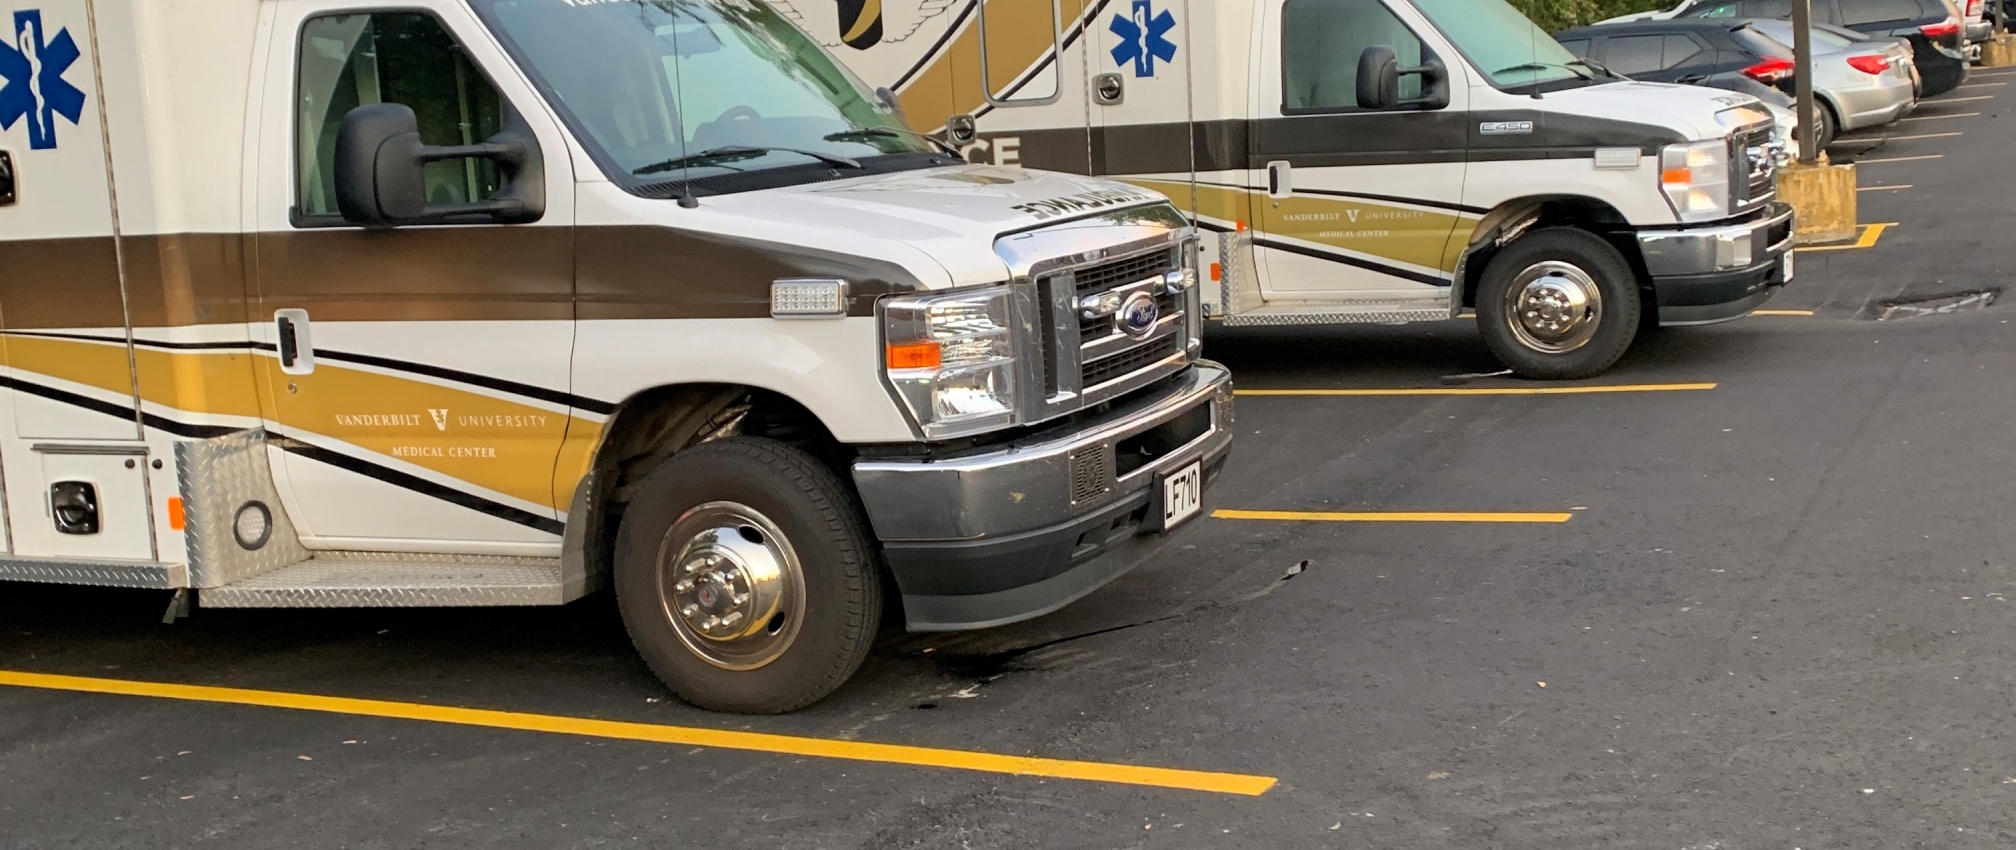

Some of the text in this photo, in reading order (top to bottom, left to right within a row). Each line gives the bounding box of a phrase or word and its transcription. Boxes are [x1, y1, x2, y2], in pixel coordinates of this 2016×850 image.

[1283, 212, 1341, 222] VANDERBILT
[1365, 211, 1425, 220] UNIVERSITY
[1318, 230, 1354, 238] MEDICAL
[335, 414, 421, 426] VANDERBILT
[458, 415, 547, 427] UNIVERSITY
[392, 446, 497, 458] MEDICAL CENTER
[1165, 468, 1198, 520] LF710
